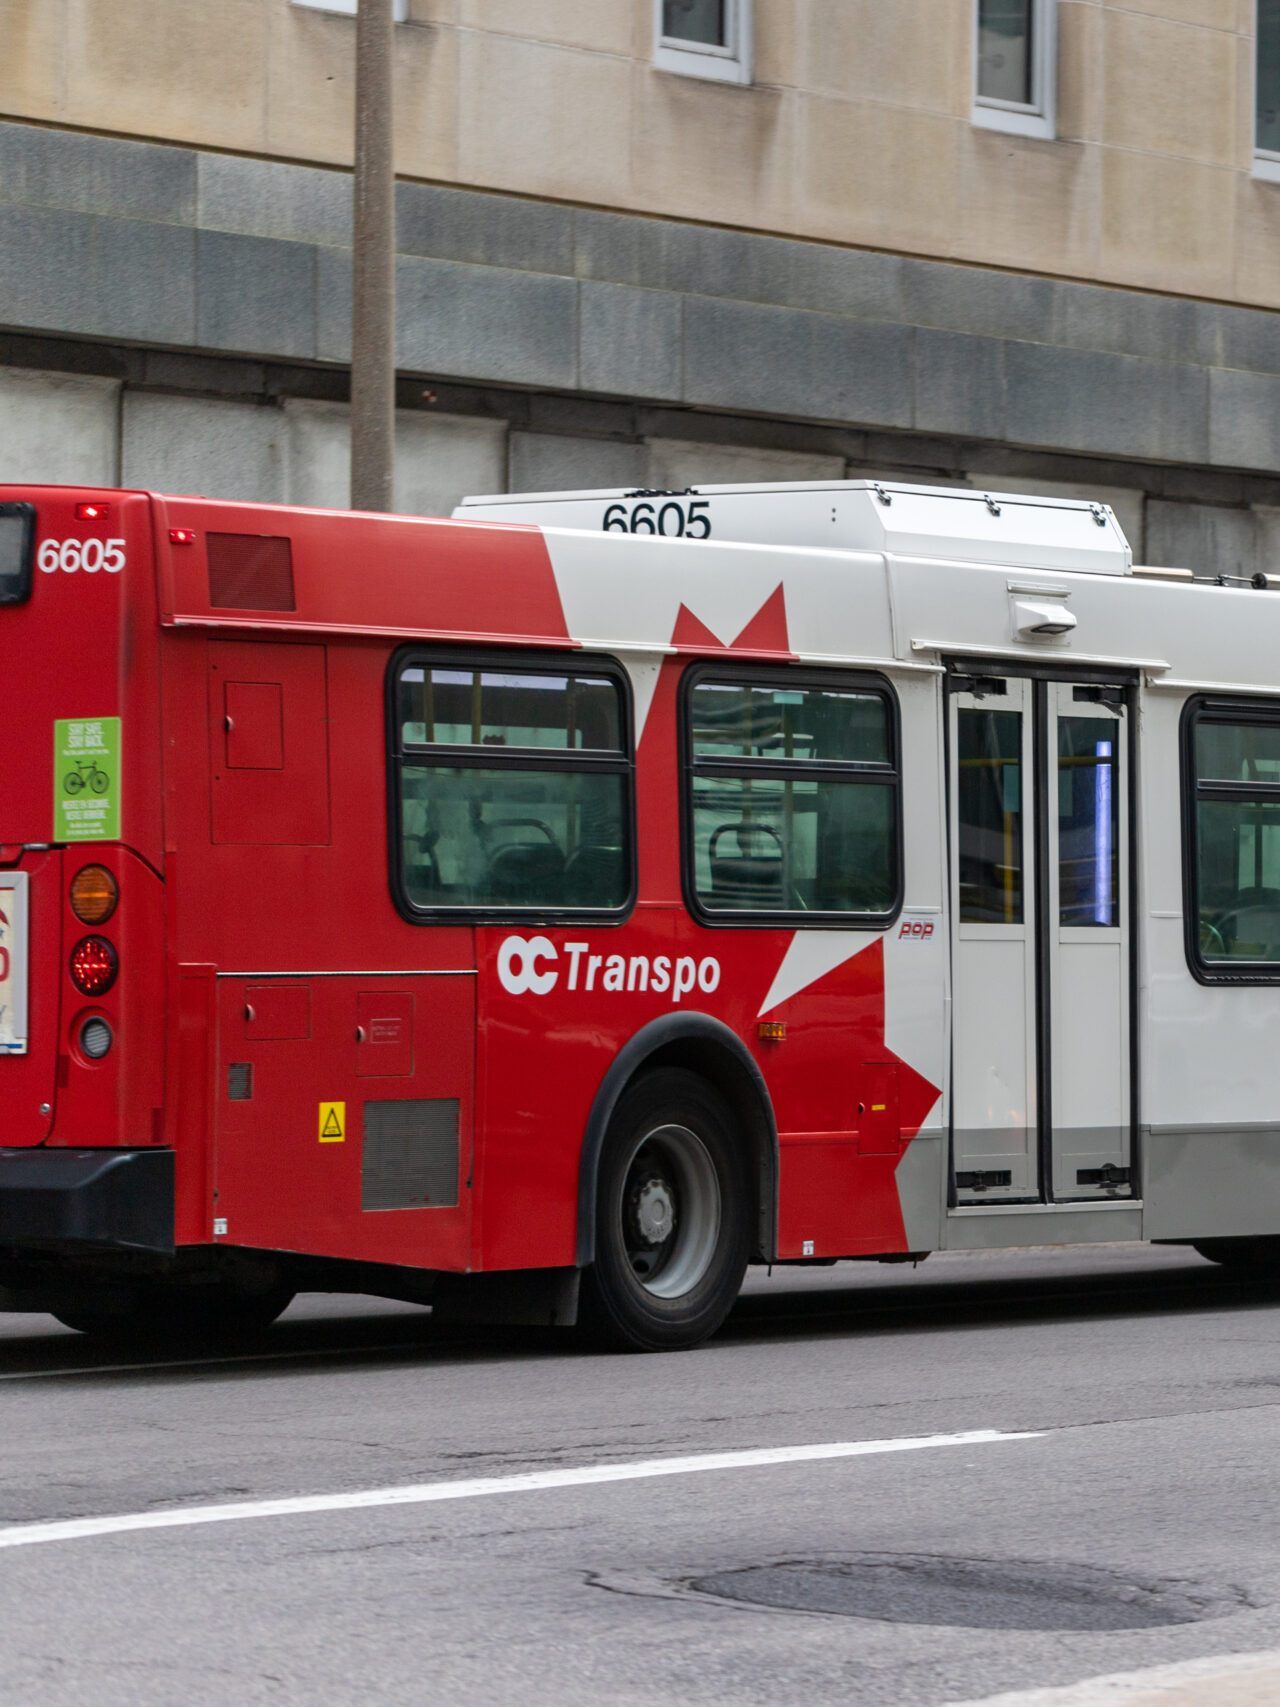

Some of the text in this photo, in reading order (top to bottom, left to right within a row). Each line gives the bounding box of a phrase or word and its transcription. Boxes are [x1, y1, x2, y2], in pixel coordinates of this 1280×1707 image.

[603, 501, 711, 540] 6605
[37, 538, 126, 573] 6605
[898, 922, 935, 940] pop
[497, 935, 721, 1003] OC Transpo
